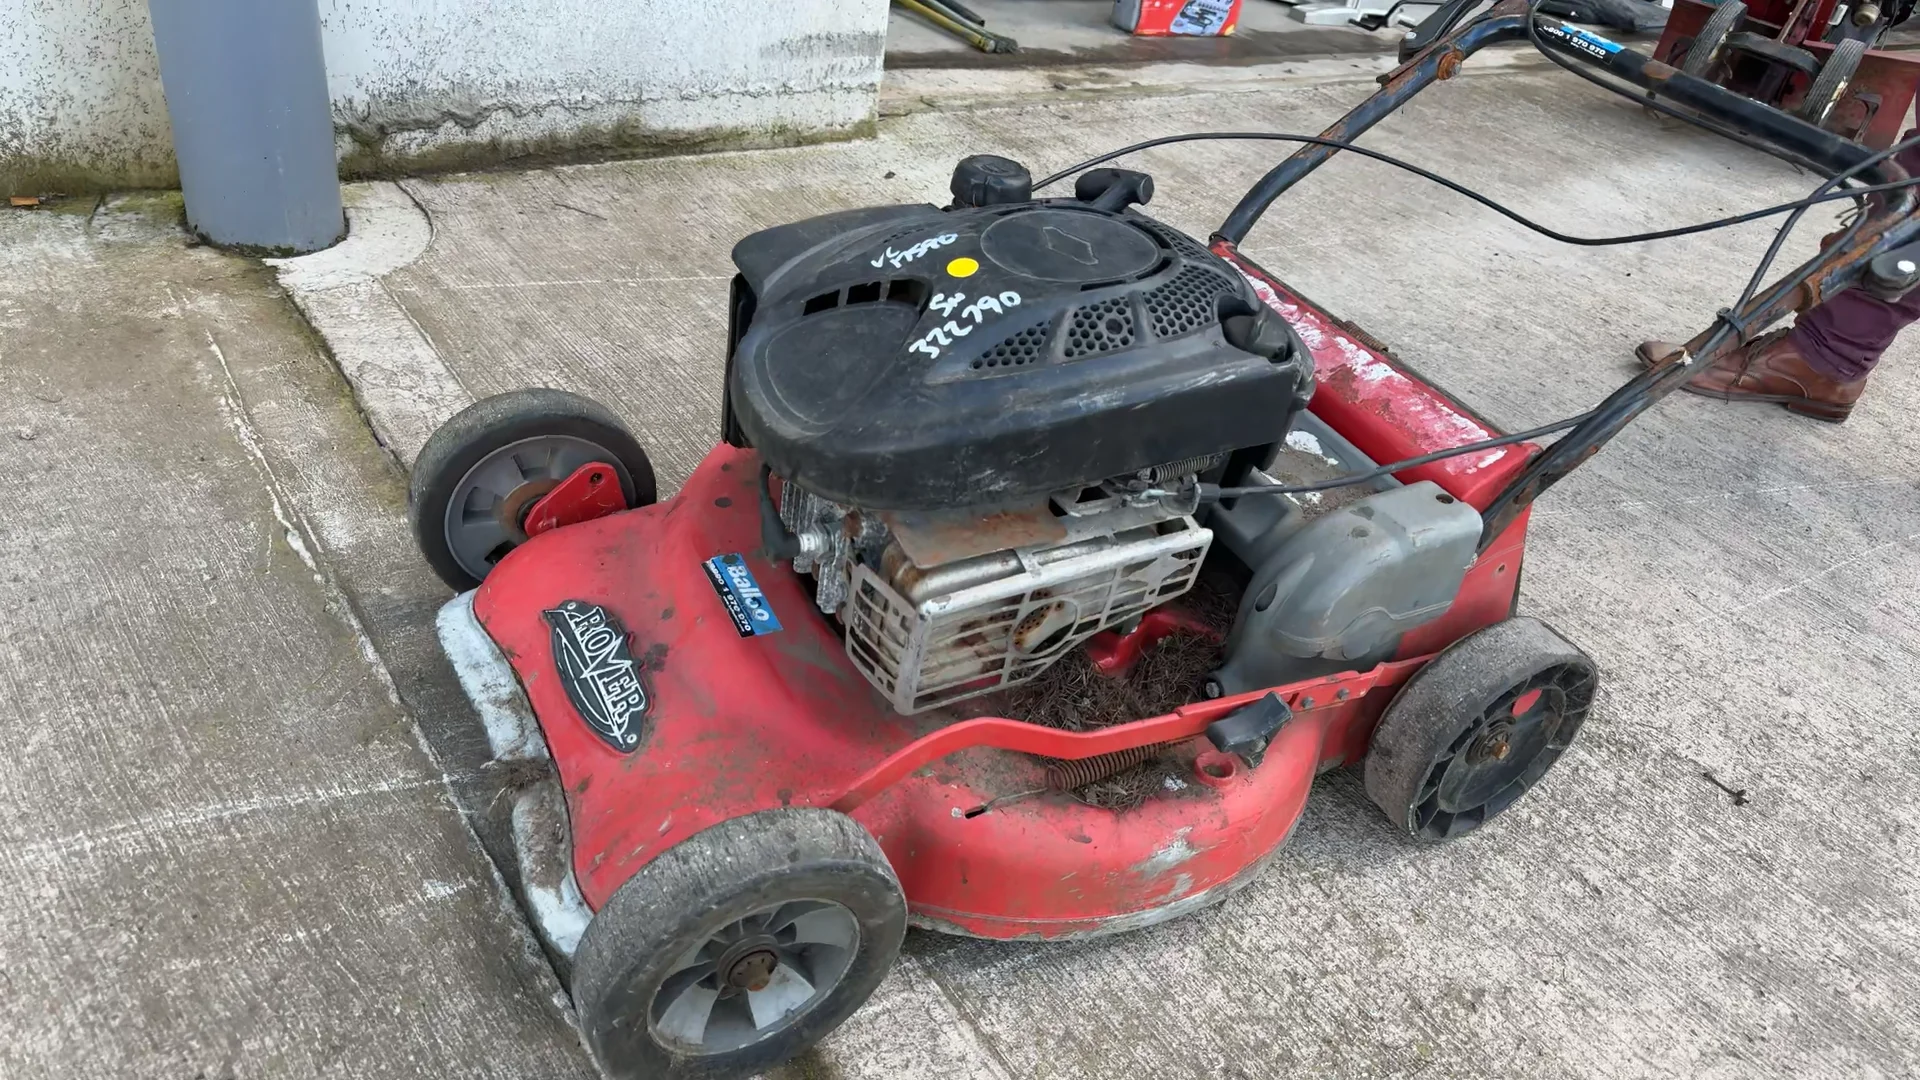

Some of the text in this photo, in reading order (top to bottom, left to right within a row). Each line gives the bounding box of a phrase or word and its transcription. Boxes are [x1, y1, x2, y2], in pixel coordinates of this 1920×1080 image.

[1572, 36, 1588, 48] 970
[1589, 44, 1606, 55] 970
[570, 606, 646, 724] ROVER
